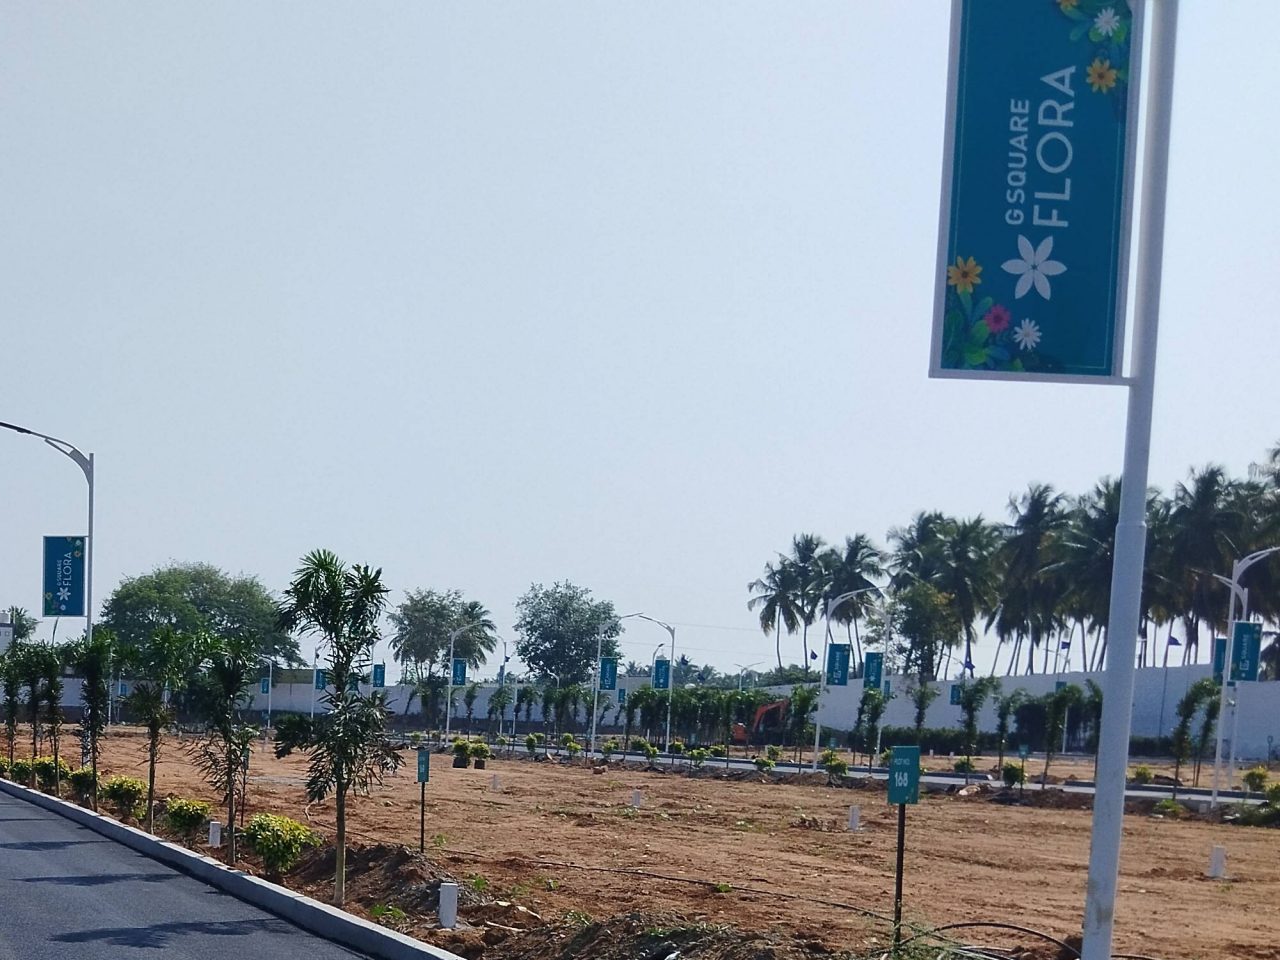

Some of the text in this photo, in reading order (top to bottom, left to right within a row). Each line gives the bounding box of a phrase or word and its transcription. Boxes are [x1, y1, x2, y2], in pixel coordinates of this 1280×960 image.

[1005, 99, 1029, 225] G SQUARE
[1032, 65, 1076, 227] FLORA
[62, 551, 72, 586] FLORA
[894, 771, 909, 787] 168
